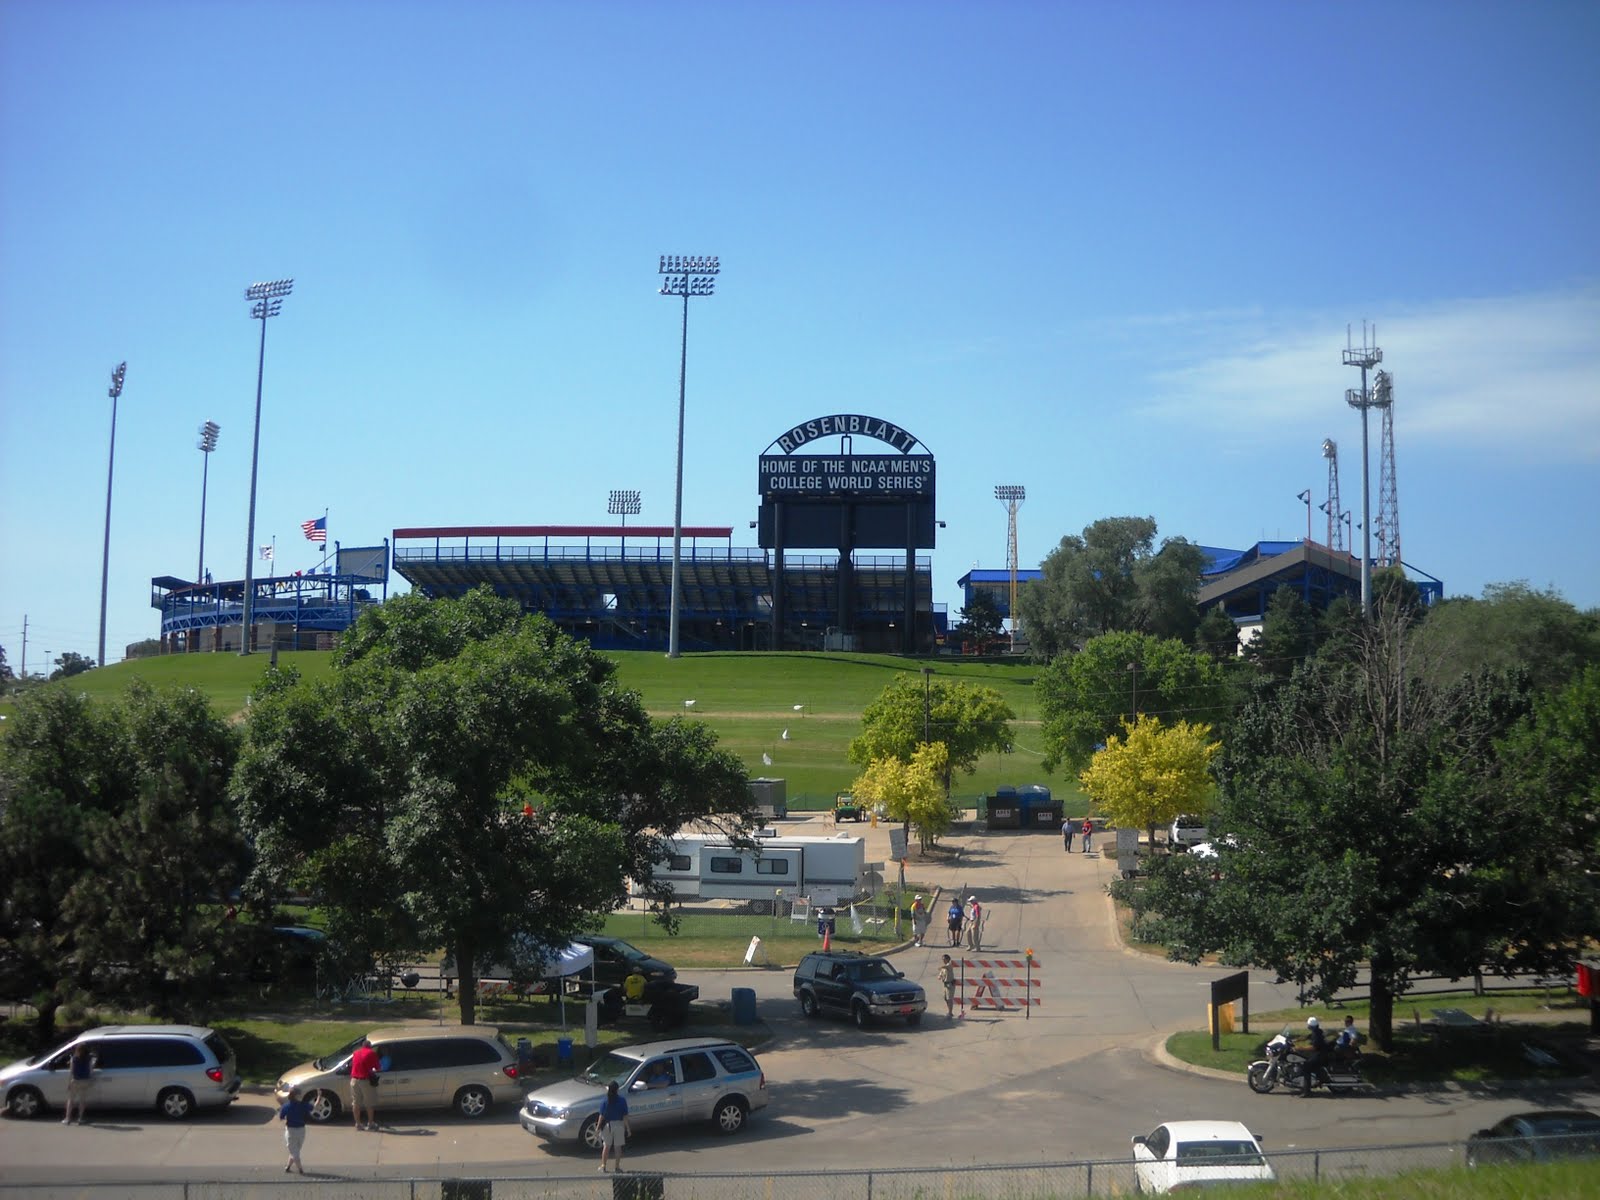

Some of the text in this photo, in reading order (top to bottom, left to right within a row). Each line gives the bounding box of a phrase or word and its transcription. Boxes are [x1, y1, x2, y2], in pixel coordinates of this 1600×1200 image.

[780, 416, 914, 452] ROSENBLATT
[761, 460, 797, 473] HOME
[802, 460, 818, 473] OF
[822, 460, 845, 473] THE
[891, 460, 930, 473] MEN'S
[770, 476, 822, 490] COLLEGE
[828, 476, 873, 490] WORLD
